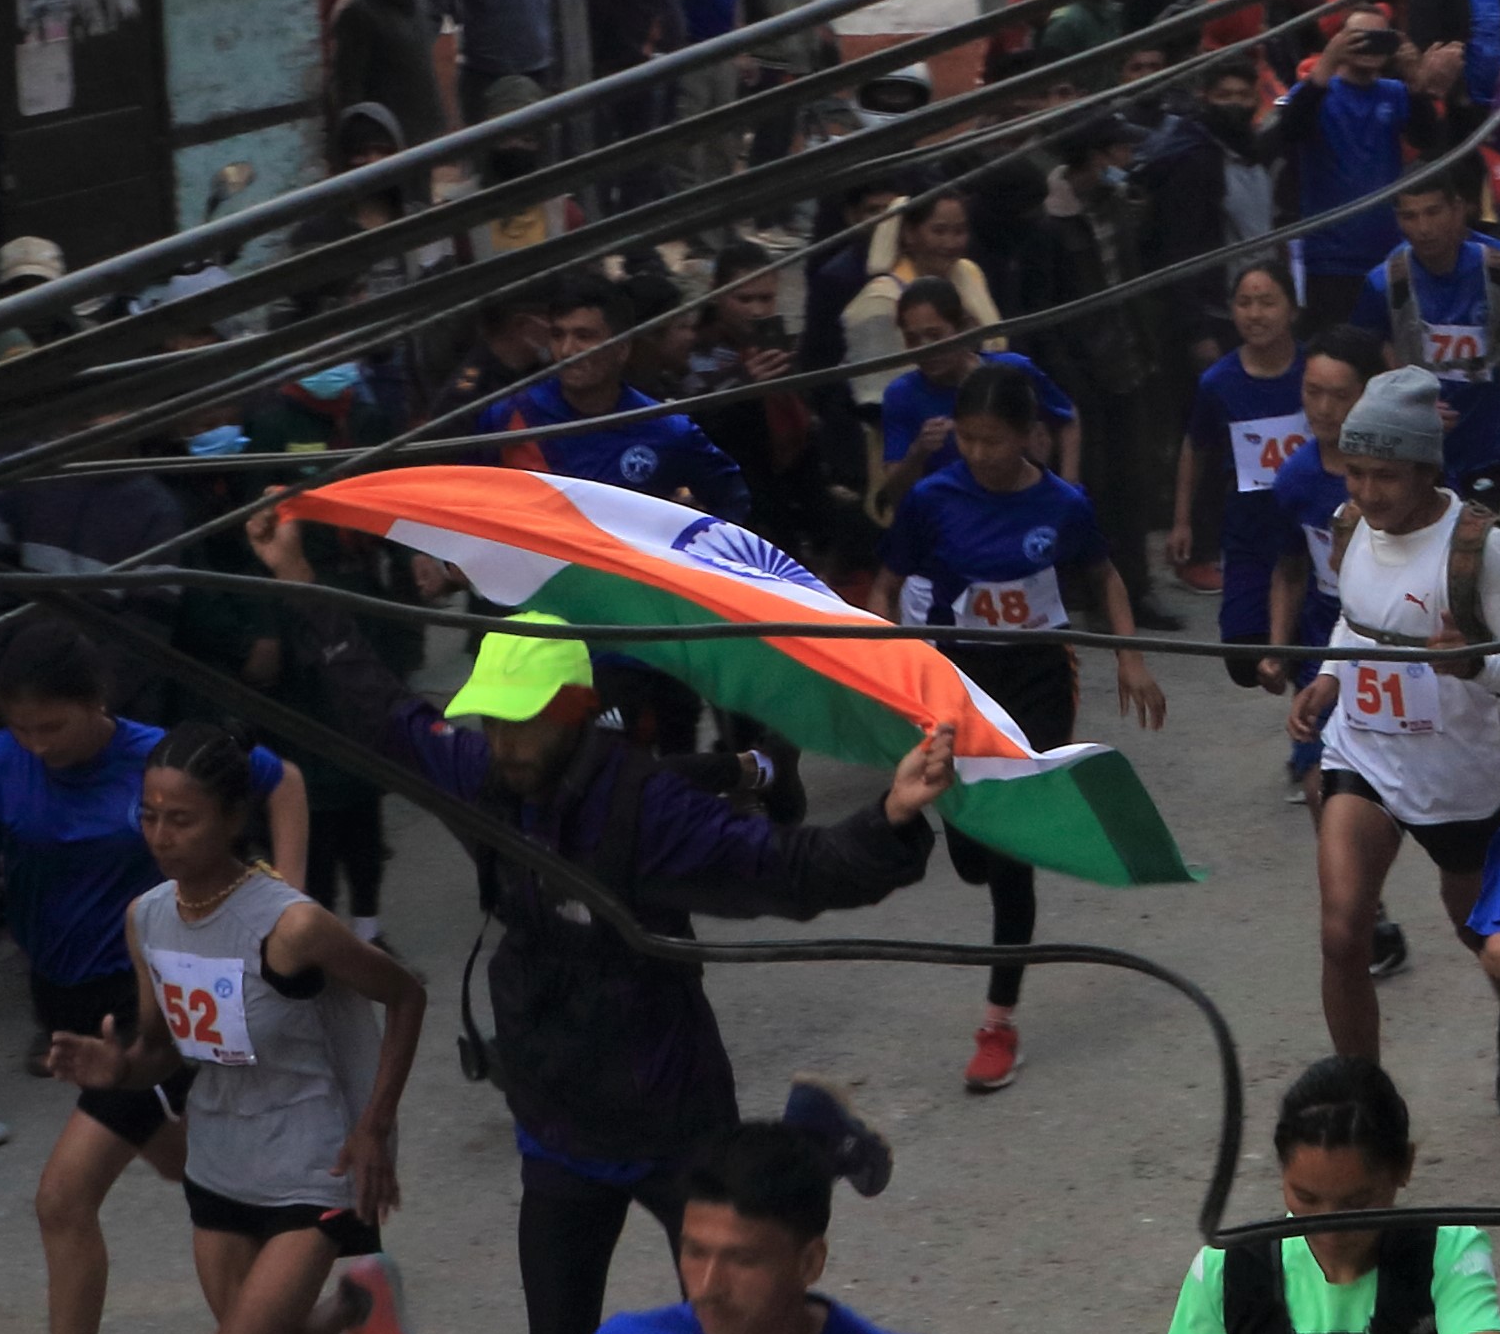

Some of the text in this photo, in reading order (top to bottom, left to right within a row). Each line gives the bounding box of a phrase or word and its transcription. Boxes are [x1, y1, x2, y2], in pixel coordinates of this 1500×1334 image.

[972, 588, 1029, 626] 48
[1356, 666, 1405, 718] 51
[163, 982, 224, 1046] 52
